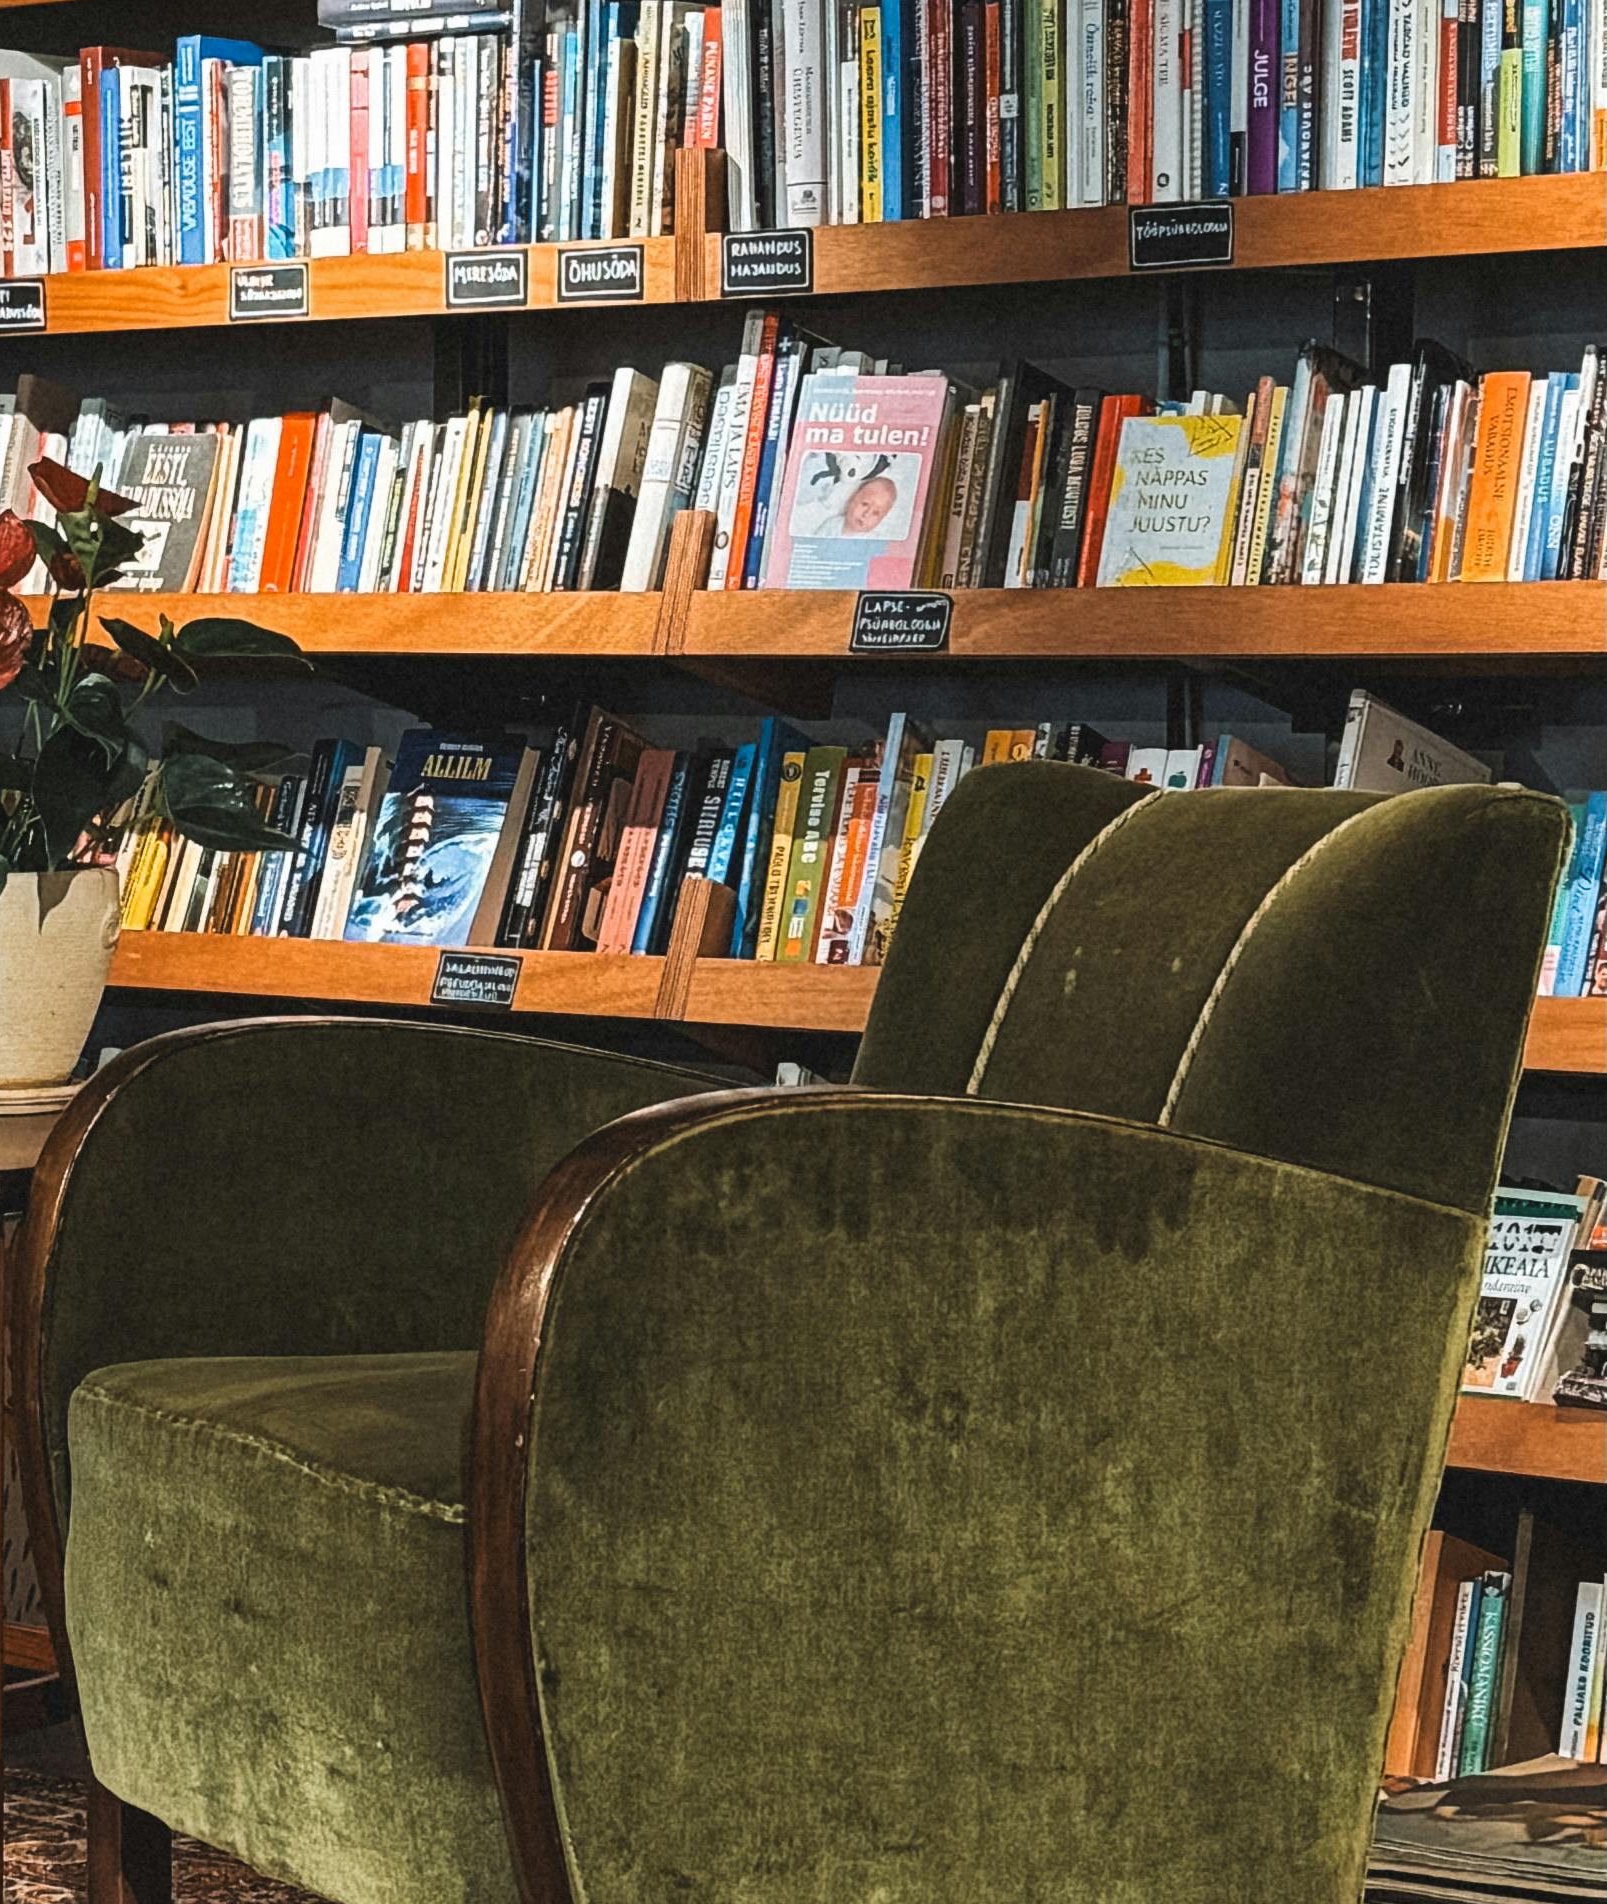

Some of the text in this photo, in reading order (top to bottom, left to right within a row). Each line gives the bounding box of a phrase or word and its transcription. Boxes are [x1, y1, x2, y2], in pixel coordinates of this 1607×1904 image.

[1252, 48, 1269, 110] JULGE
[568, 252, 638, 285] ÕHUSÕDA
[808, 401, 878, 426] Nüüd
[804, 422, 930, 449] ma tulen!
[420, 752, 494, 781] ALLILM
